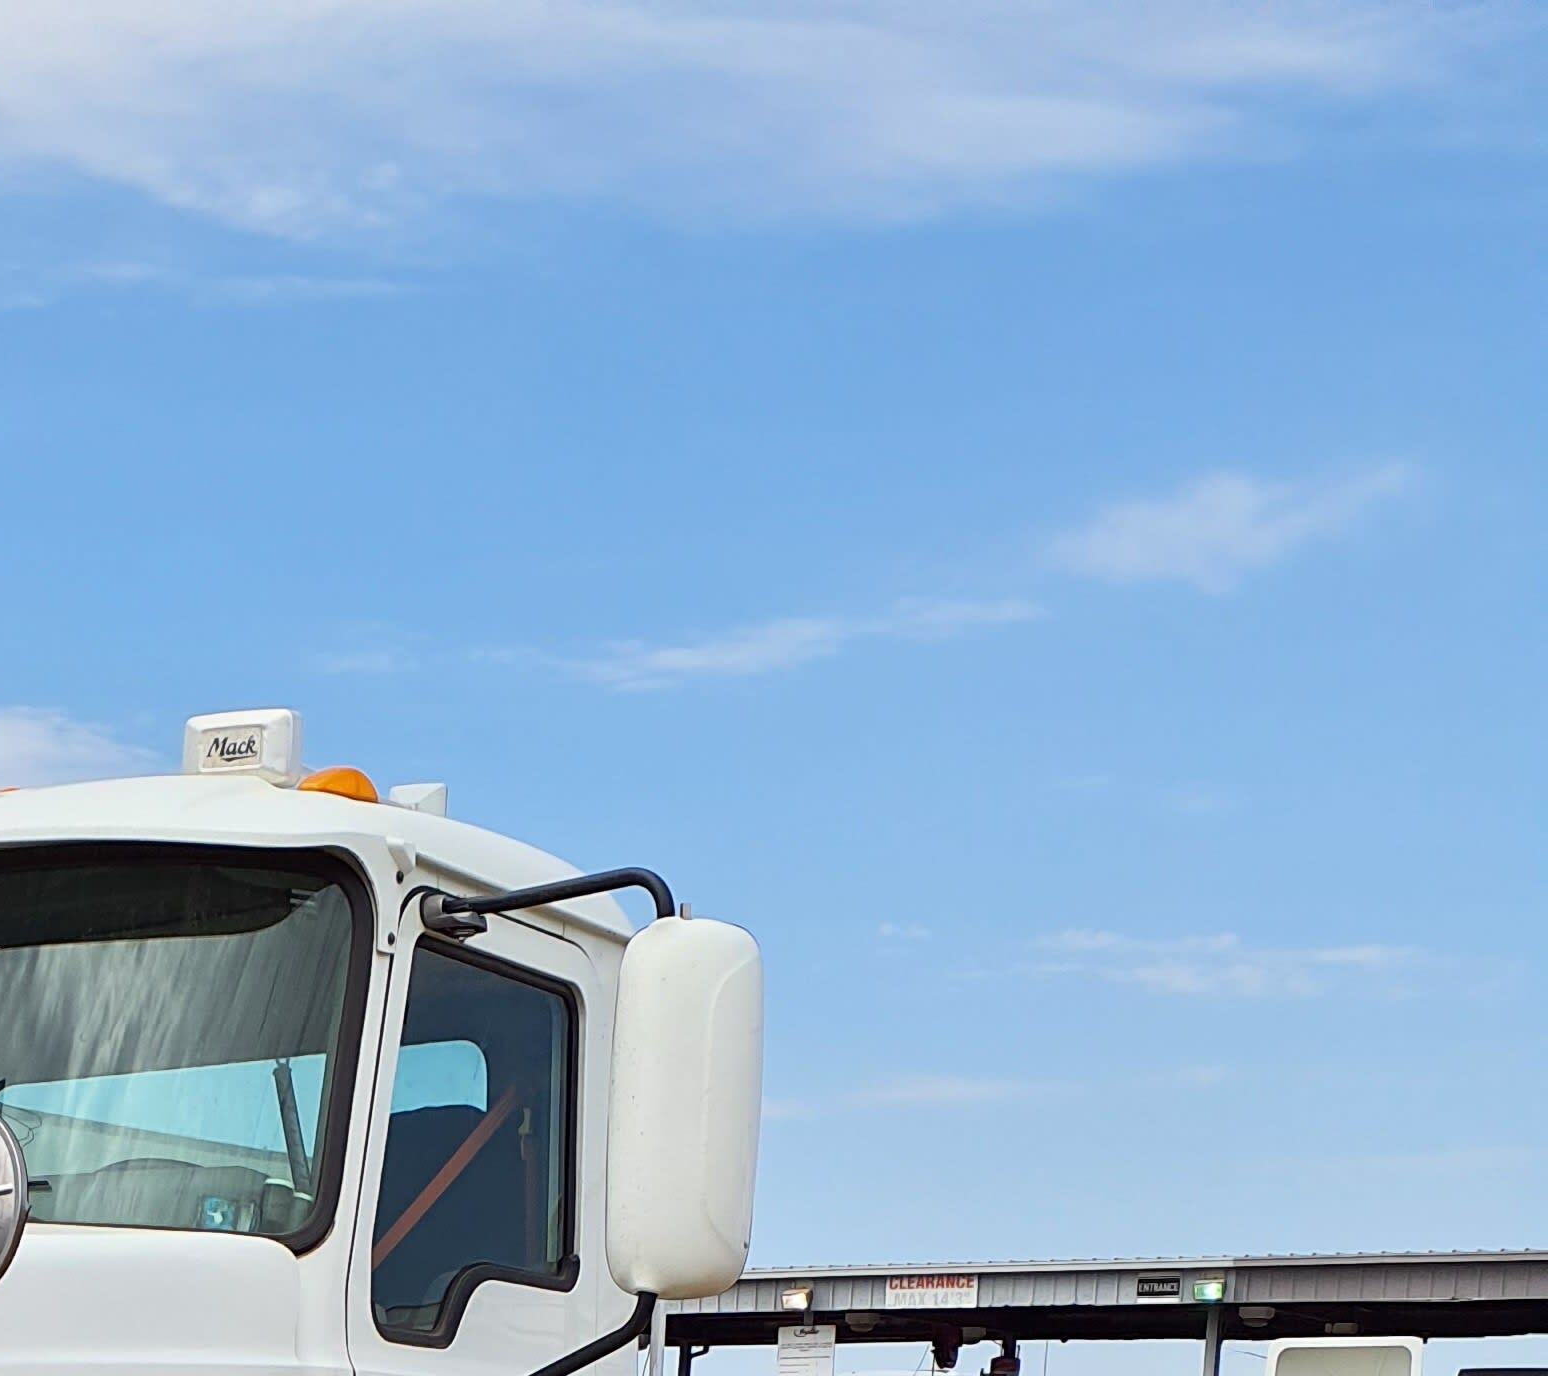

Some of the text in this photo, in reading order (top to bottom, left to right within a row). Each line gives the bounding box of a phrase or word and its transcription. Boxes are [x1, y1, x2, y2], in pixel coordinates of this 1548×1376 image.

[206, 735, 258, 762] Mack
[889, 1275, 975, 1290] CLEARANCE
[1138, 1282, 1179, 1293] ENTRANCE
